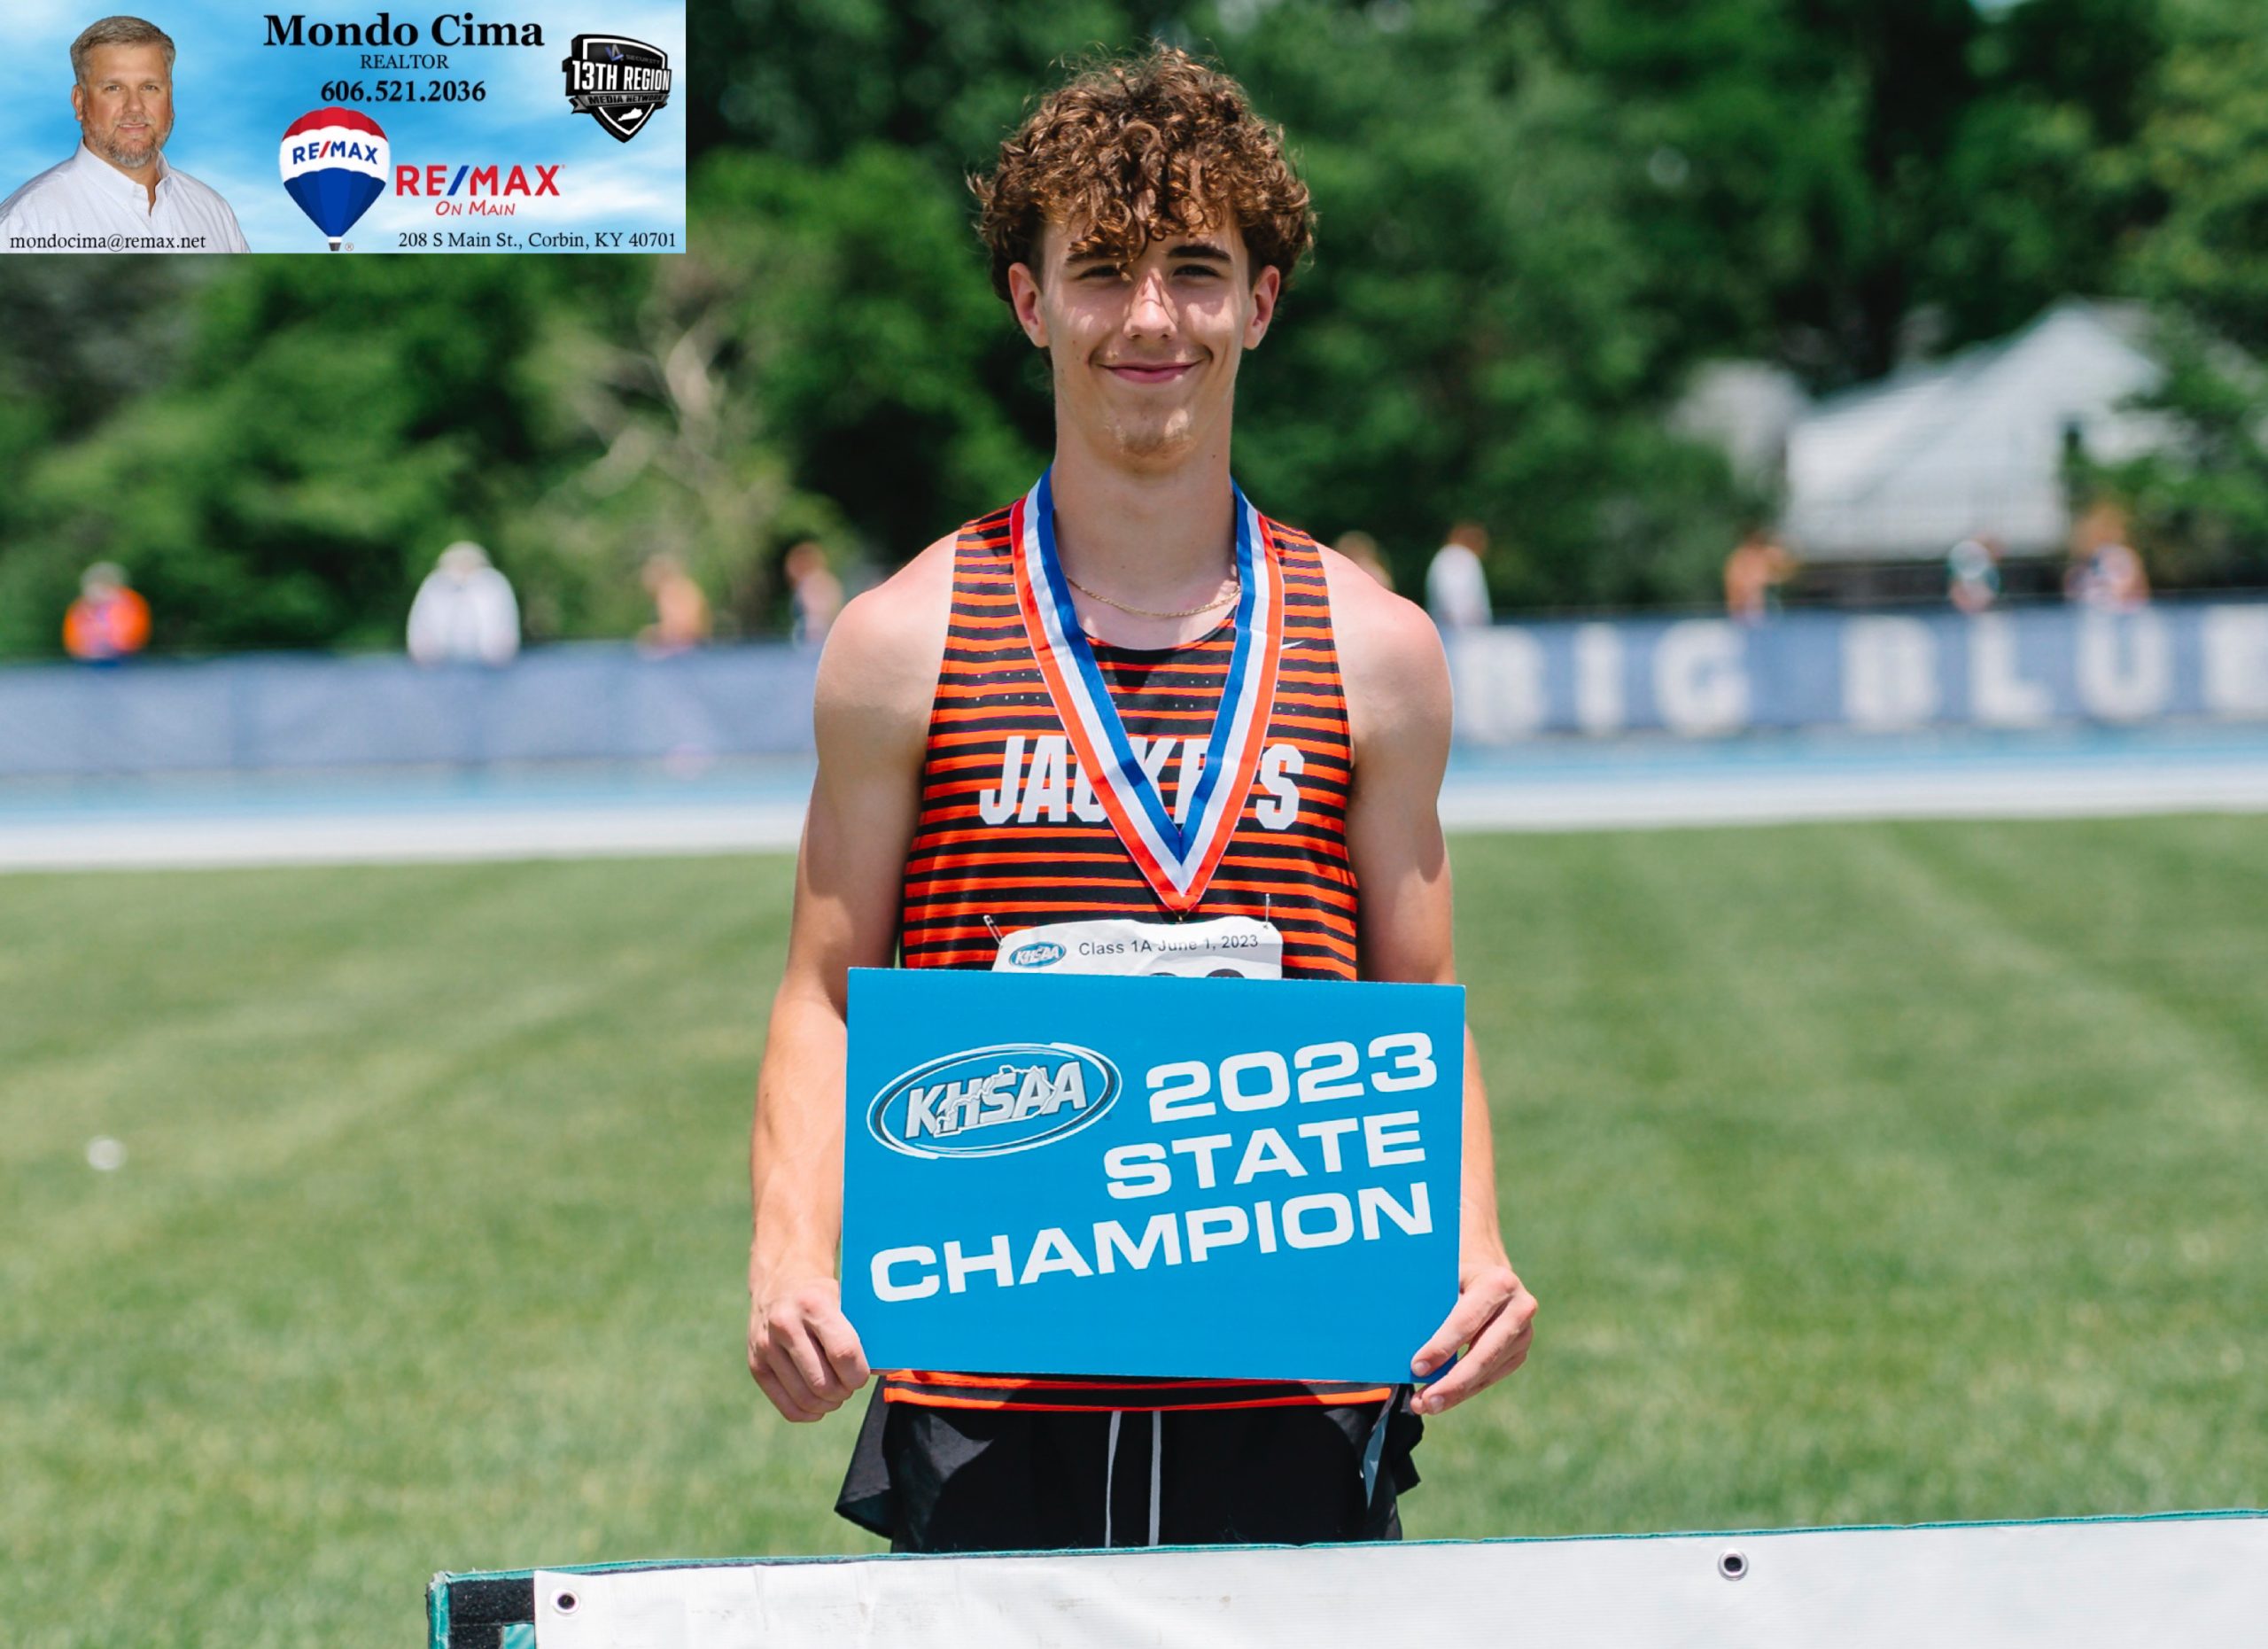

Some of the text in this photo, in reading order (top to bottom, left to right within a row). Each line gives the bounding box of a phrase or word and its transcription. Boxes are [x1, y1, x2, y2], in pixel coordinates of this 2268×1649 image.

[1455, 619, 1751, 741] BIG
[1079, 934, 1259, 956] Class 1A June 1, 2023
[905, 1061, 1088, 1140] KHSAA
[1146, 1033, 1437, 1124] 2023
[1104, 1110, 1426, 1200] STATE
[870, 1182, 1433, 1303] CHAMPION
